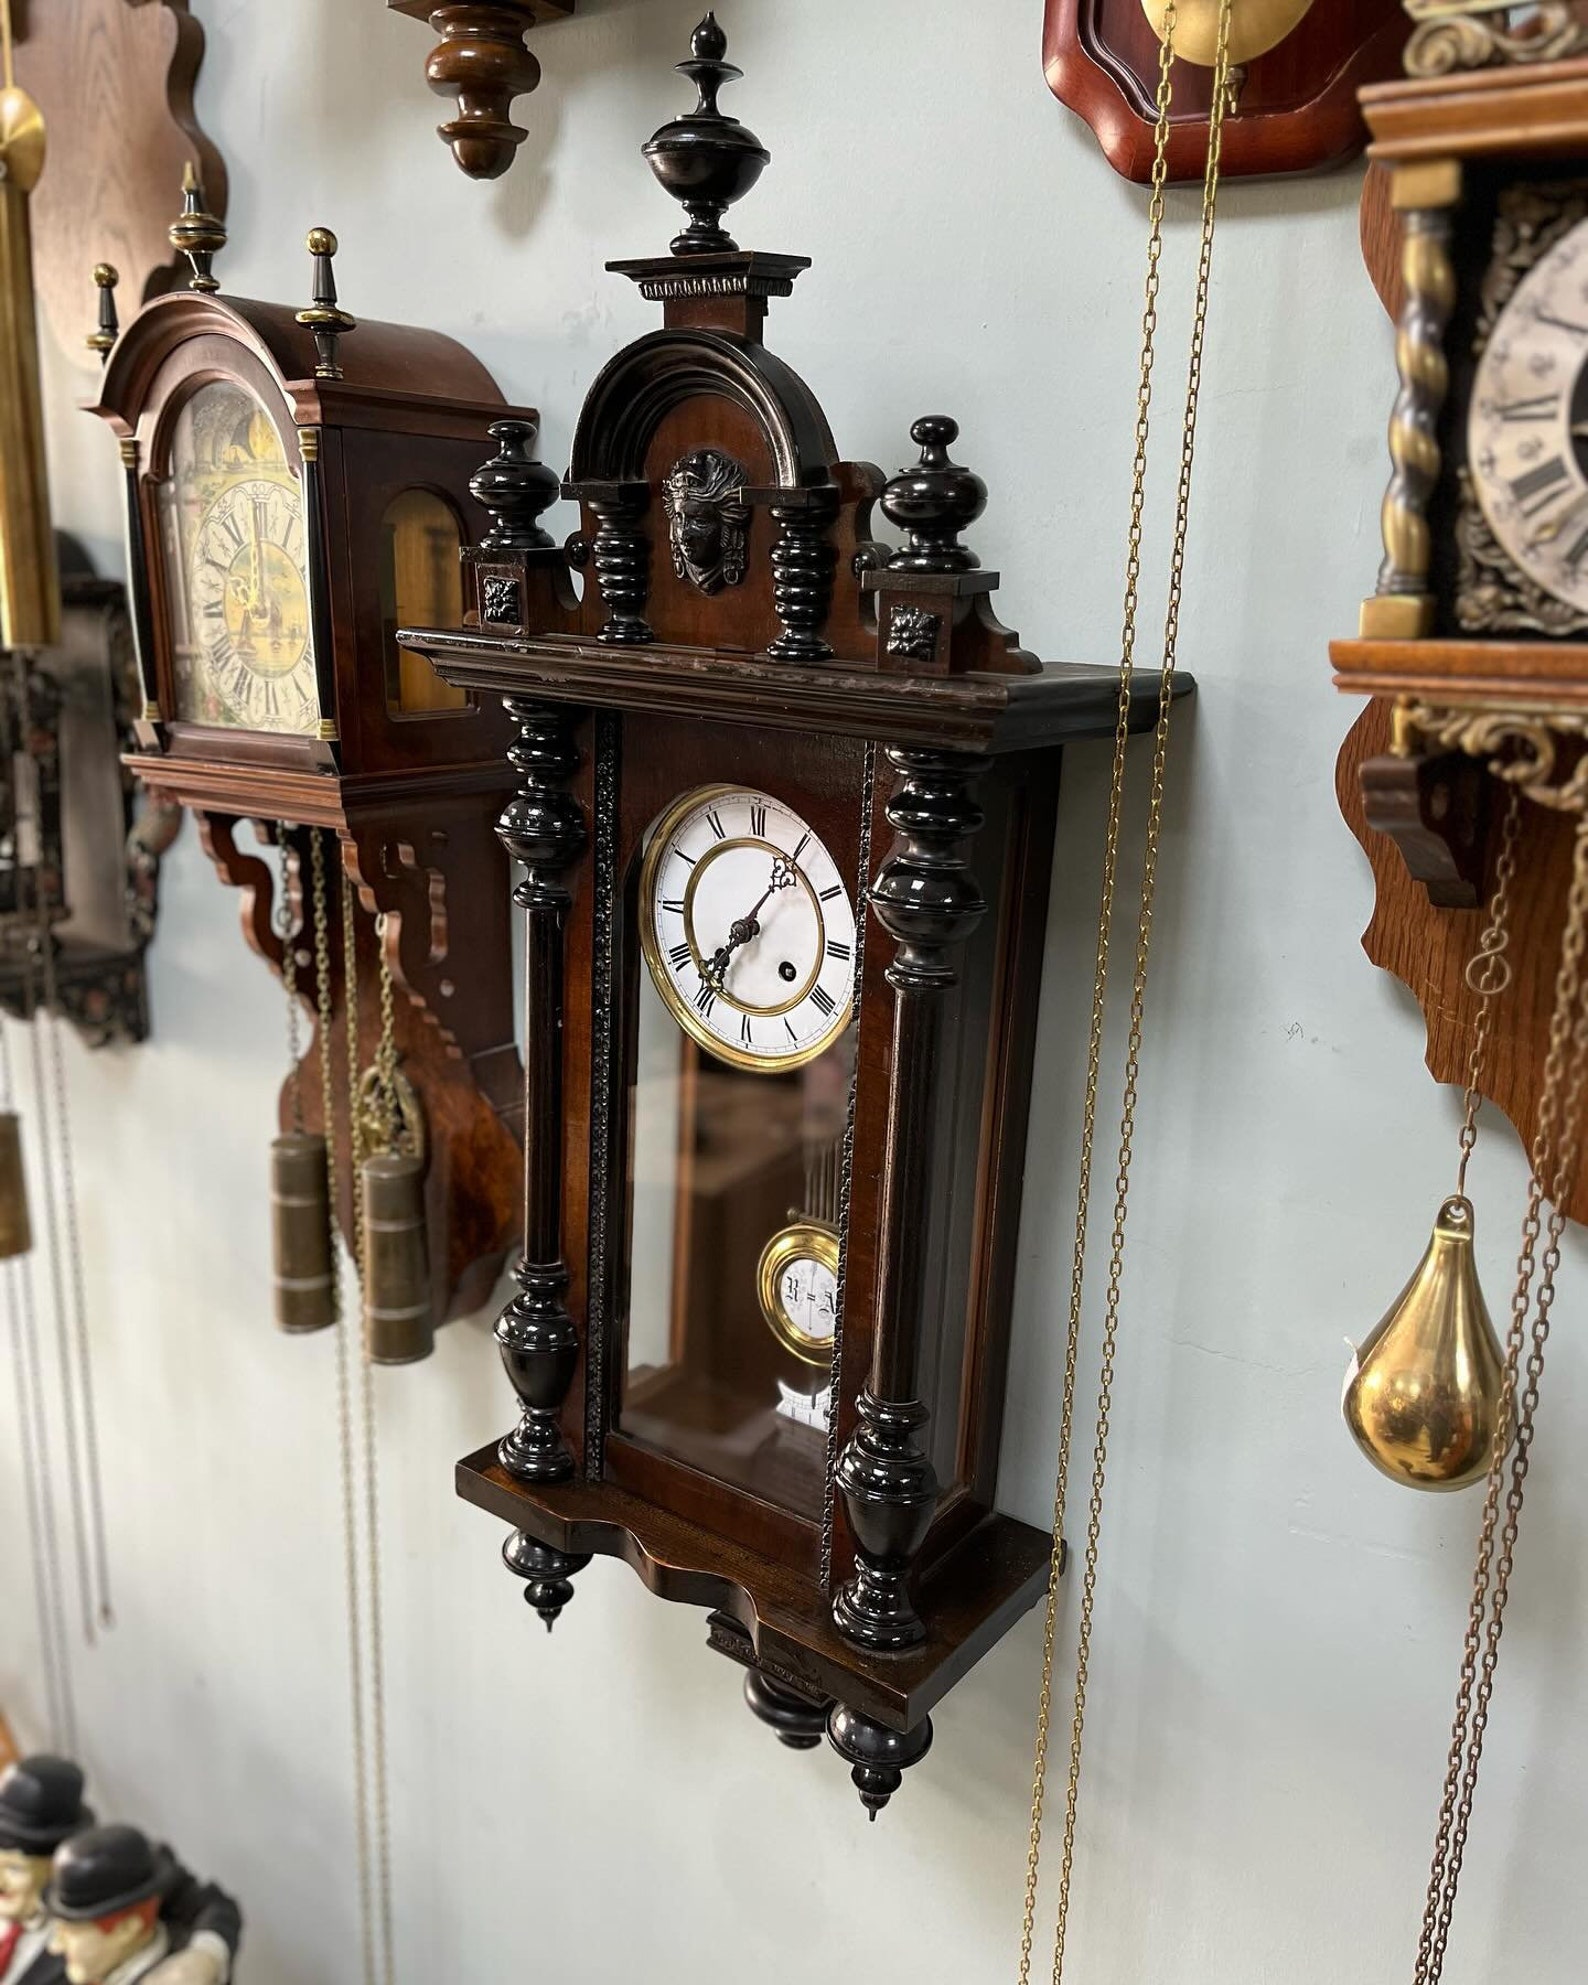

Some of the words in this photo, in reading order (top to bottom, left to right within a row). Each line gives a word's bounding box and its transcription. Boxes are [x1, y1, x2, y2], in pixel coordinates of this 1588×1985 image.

[818, 883, 843, 902] II
[826, 939, 850, 961] III
[809, 983, 837, 1017] IIII
